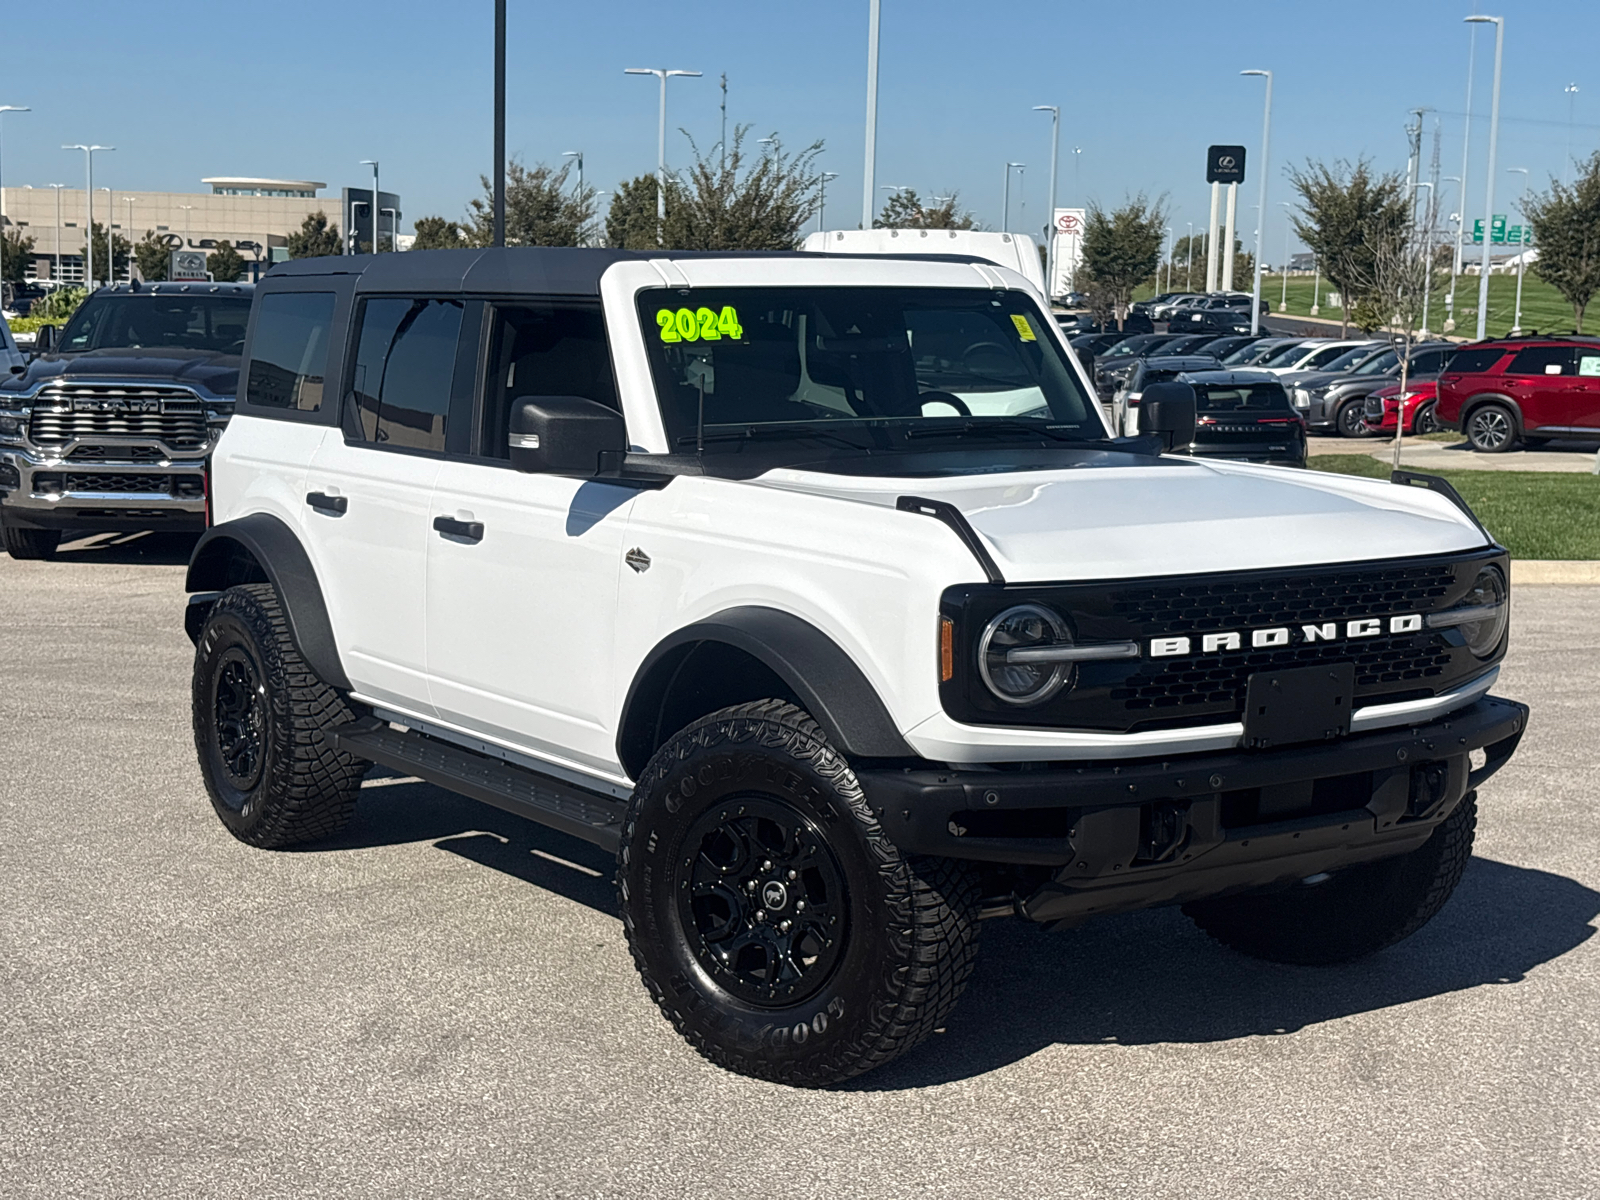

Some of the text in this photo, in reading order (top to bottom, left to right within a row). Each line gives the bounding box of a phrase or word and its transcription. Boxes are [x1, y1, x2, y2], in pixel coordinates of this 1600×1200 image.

[656, 306, 743, 343] 2024
[73, 397, 159, 412] RAM
[1150, 613, 1422, 657] BRONCO
[646, 829, 660, 854] MT
